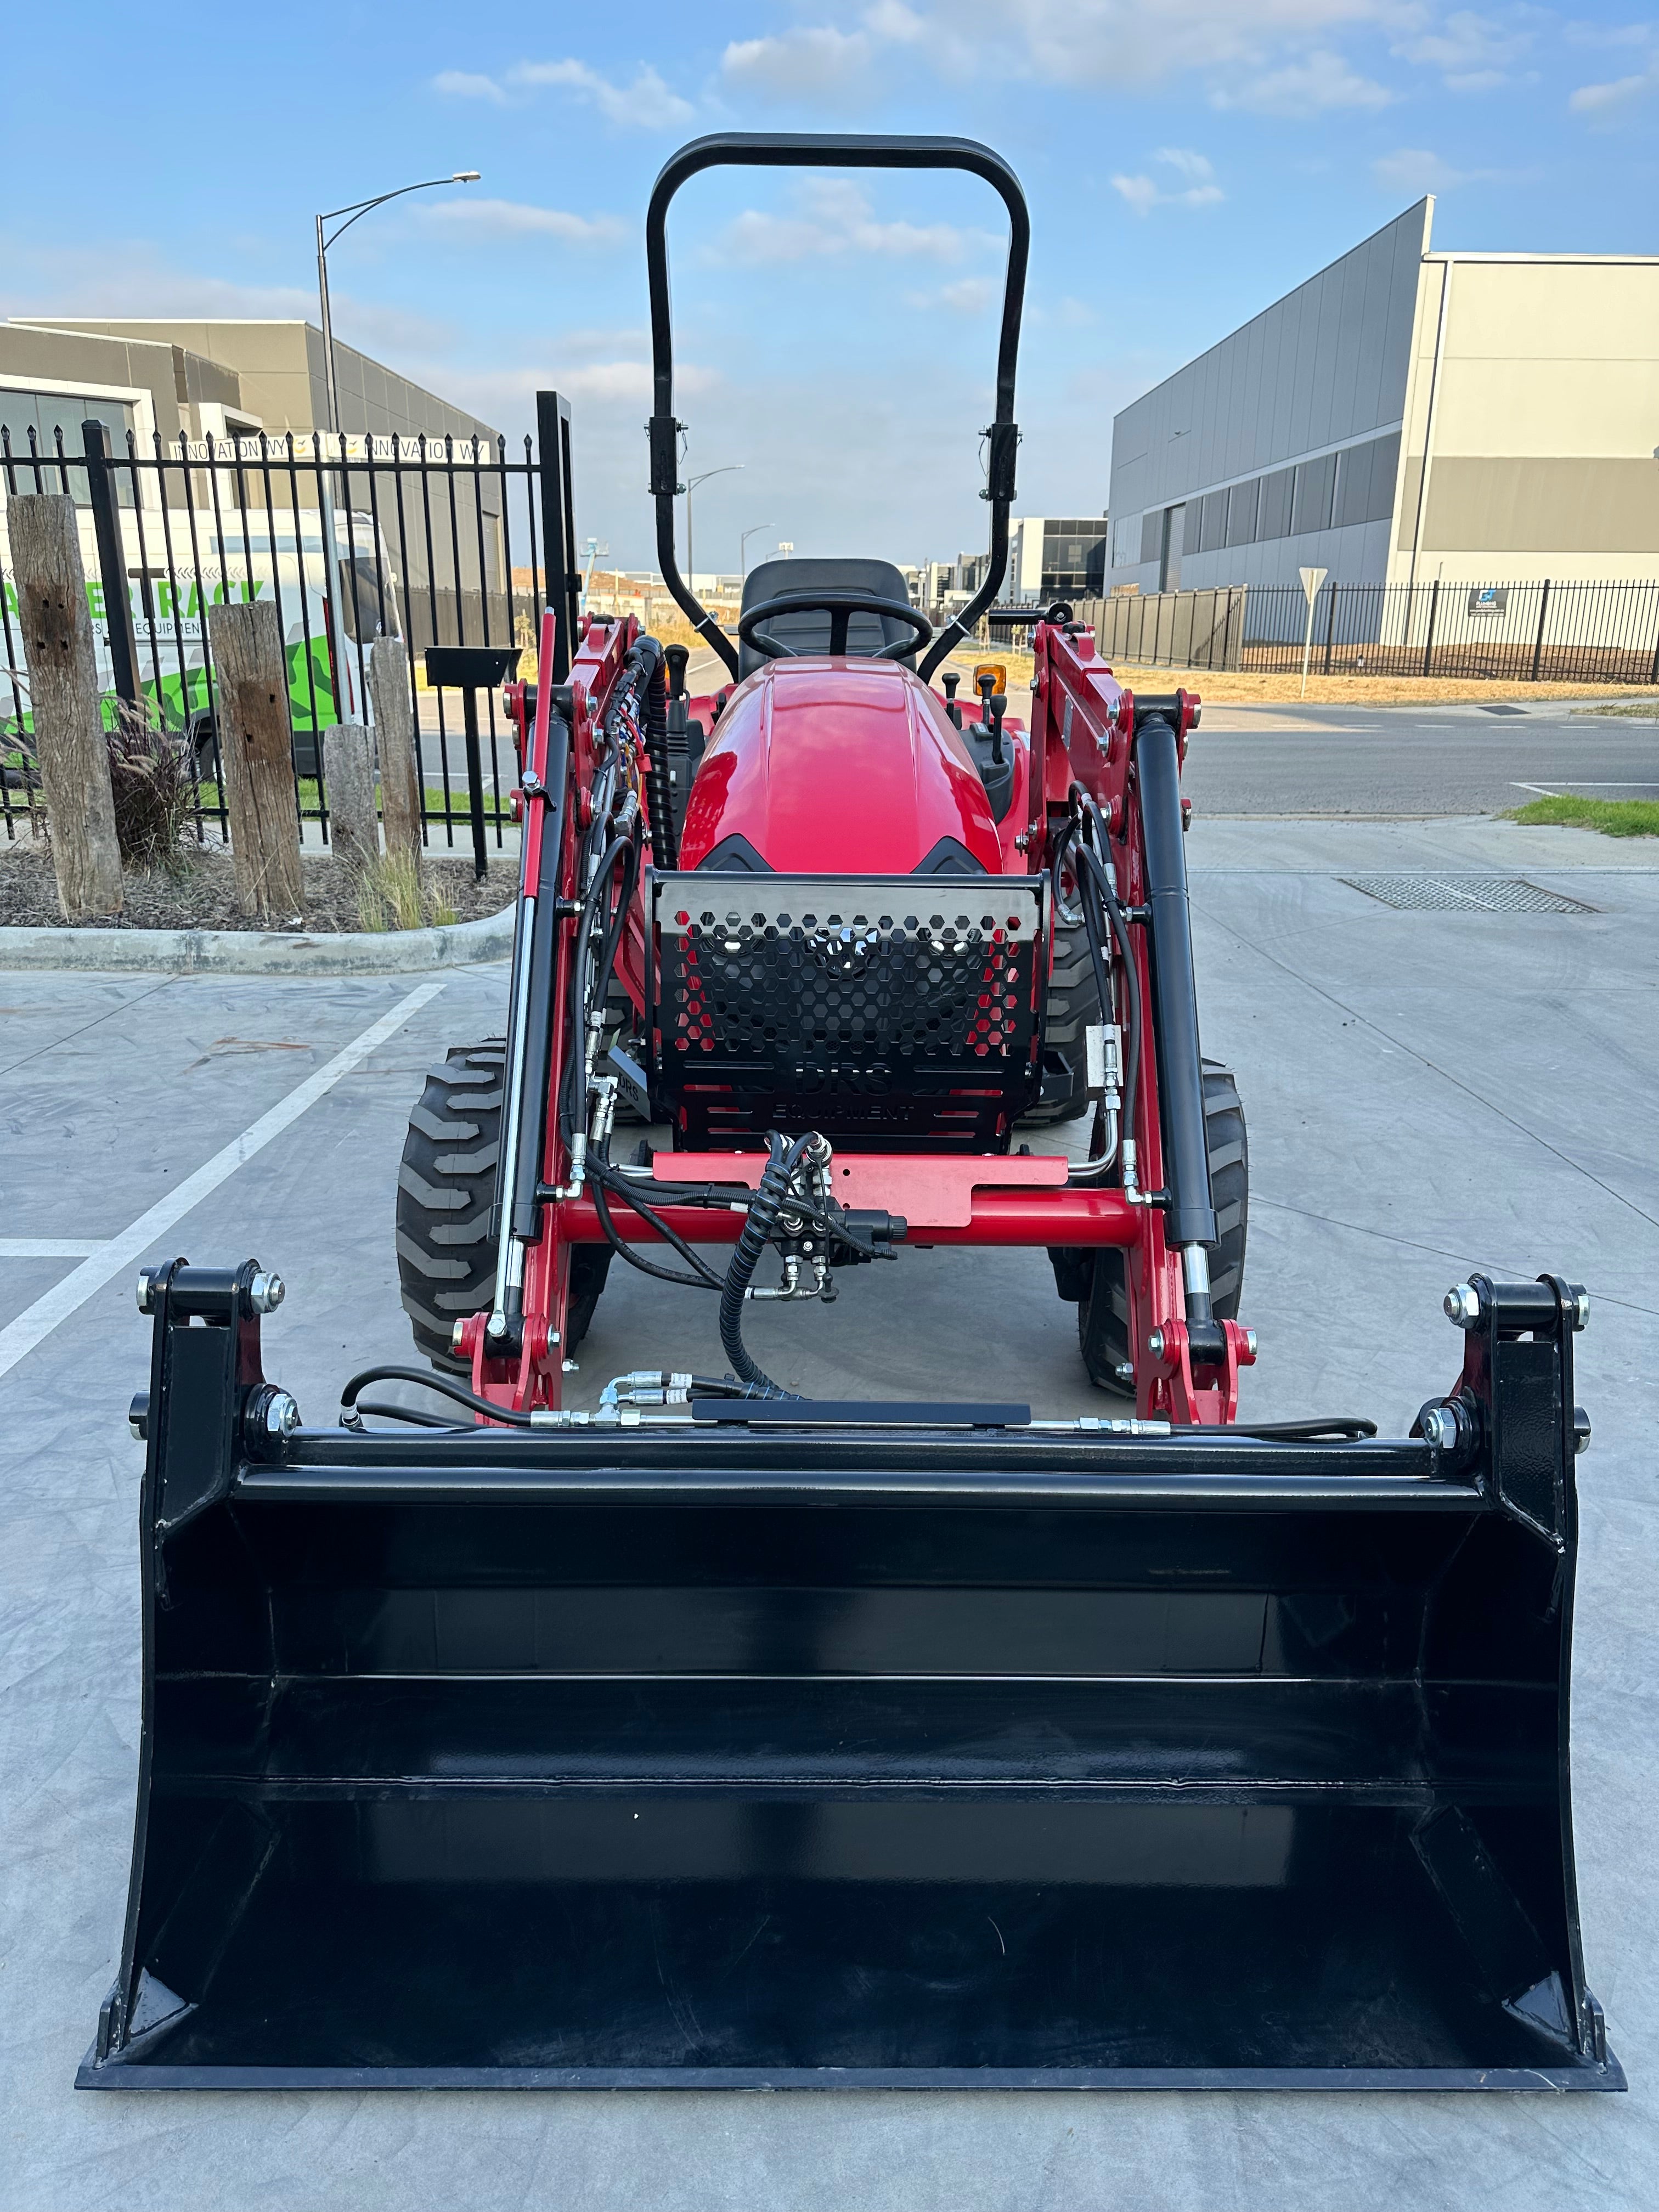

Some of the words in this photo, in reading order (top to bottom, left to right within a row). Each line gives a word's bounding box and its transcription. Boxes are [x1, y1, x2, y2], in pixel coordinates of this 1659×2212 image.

[174, 441, 258, 460] INOATON
[364, 439, 454, 460] INNOVAIO
[136, 623, 200, 635] EQUIPEN
[795, 1062, 892, 1096] DRS
[772, 1103, 915, 1120] EQUIPMENT
